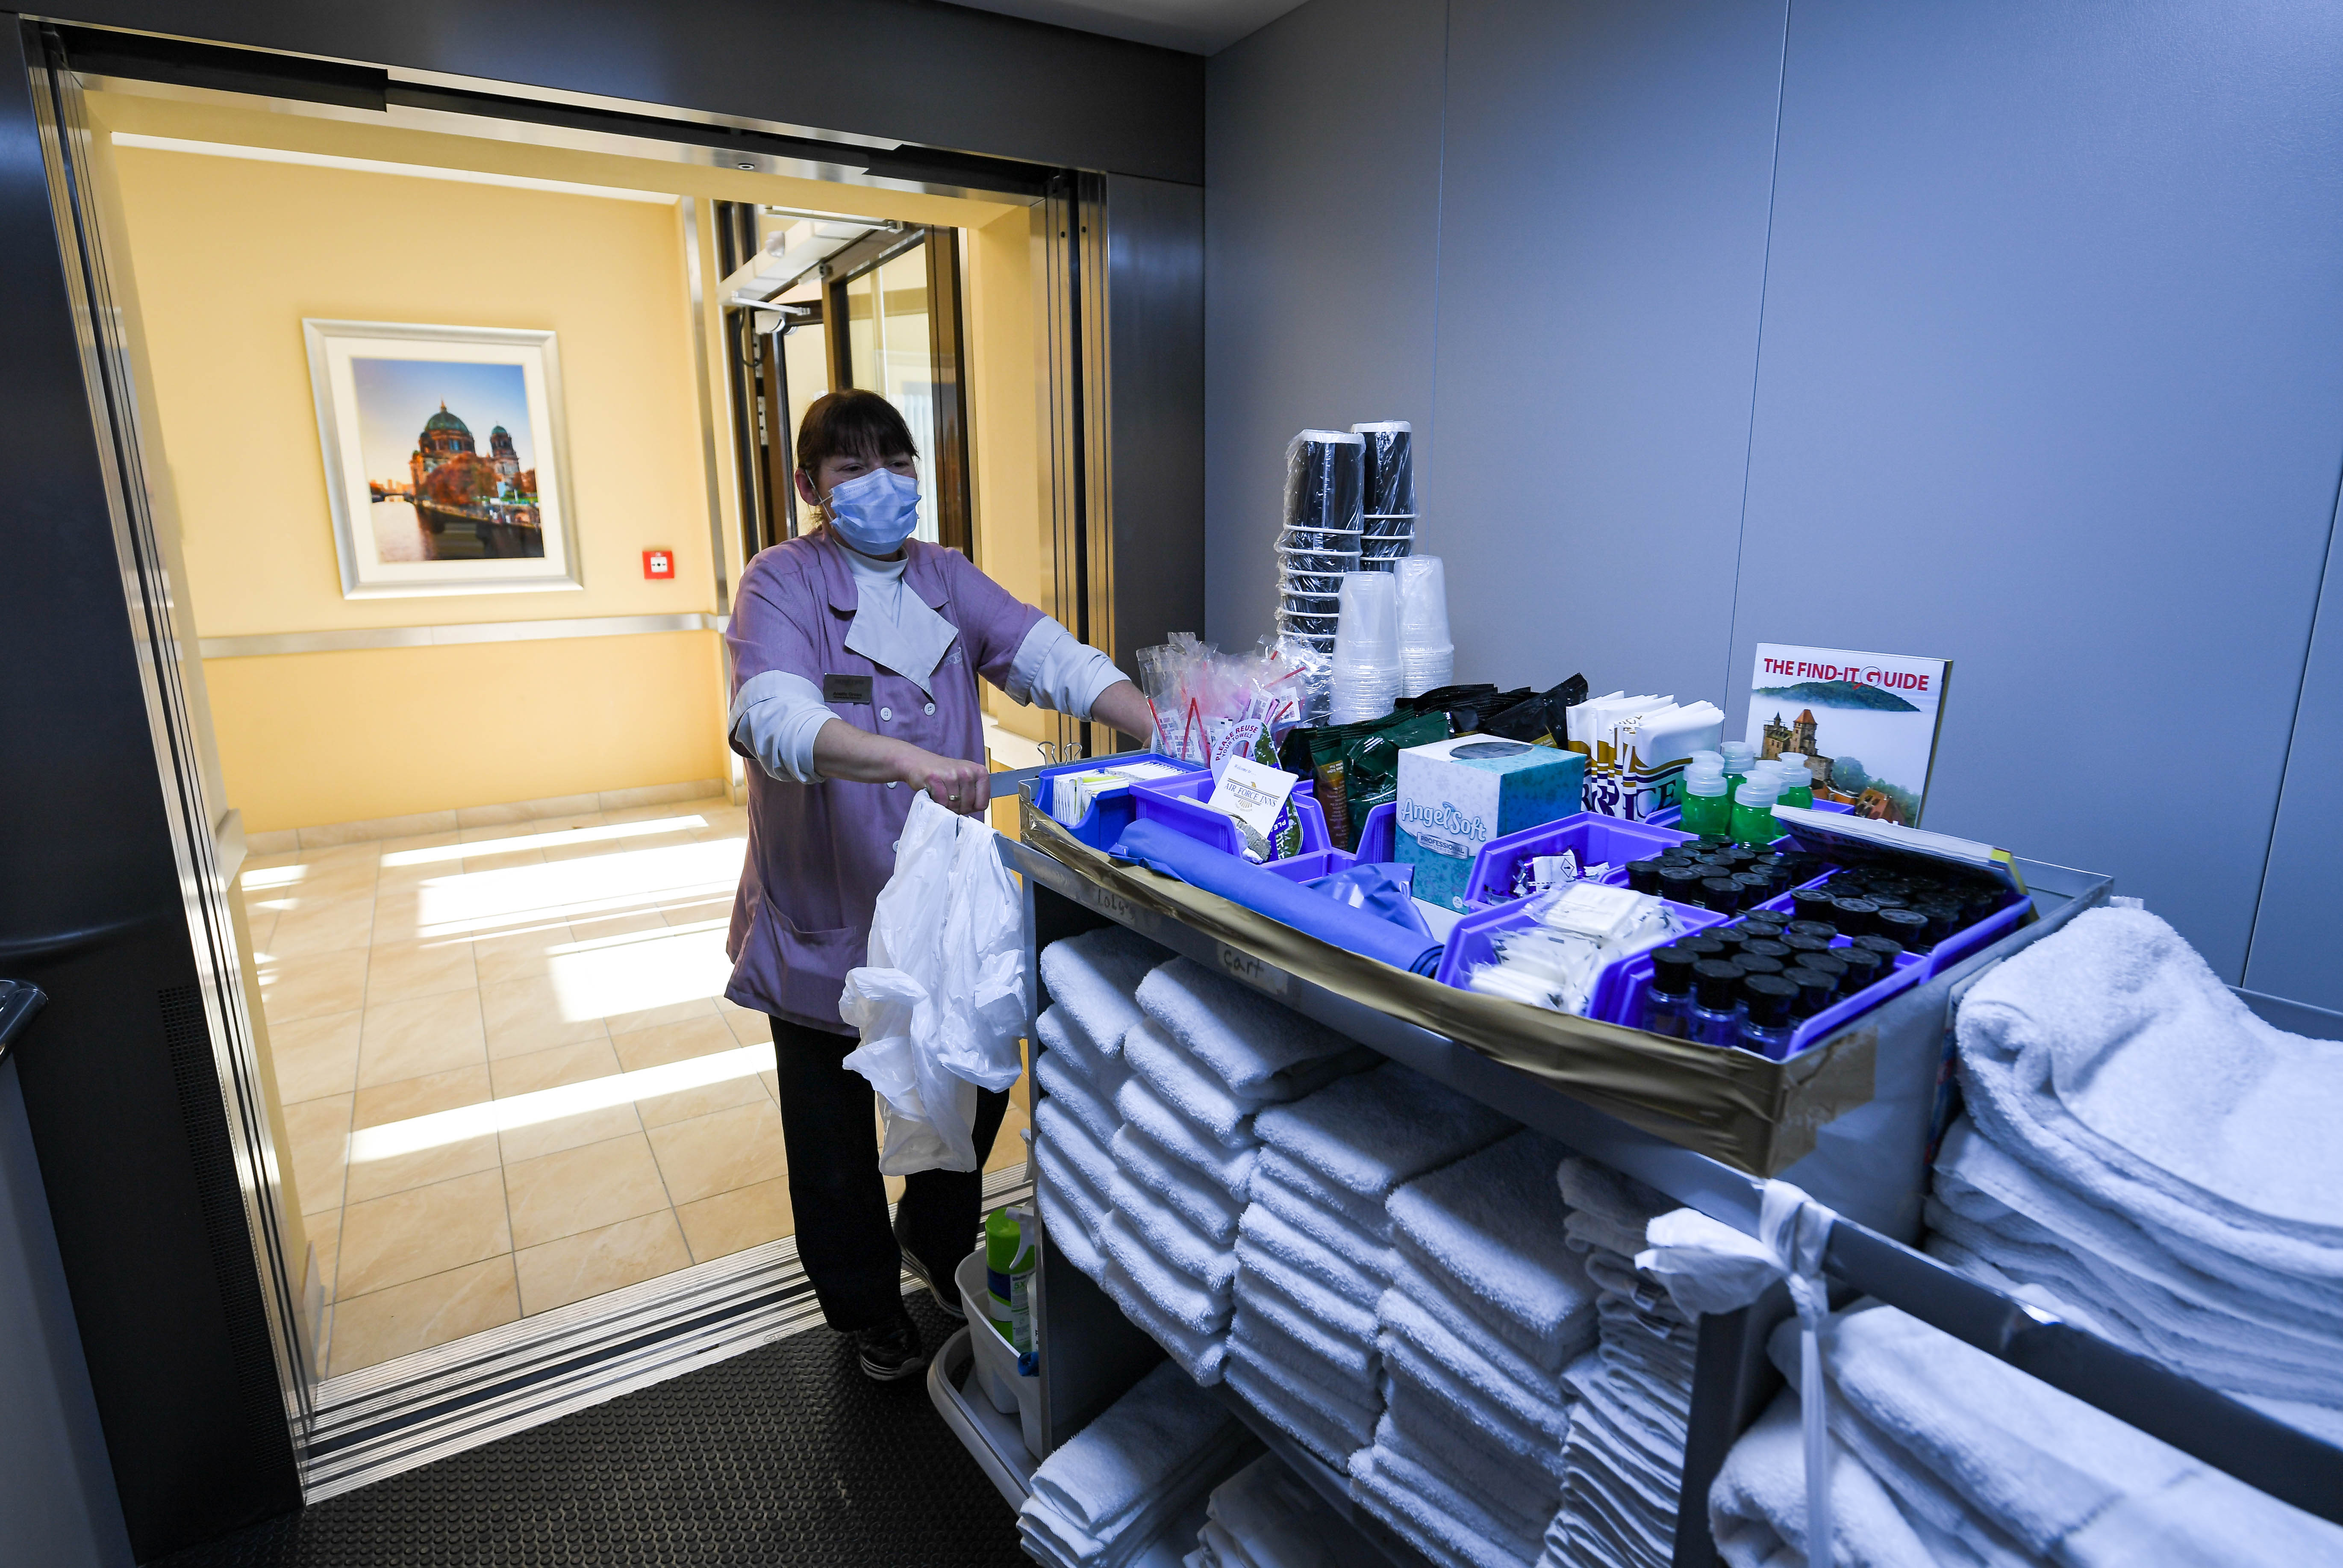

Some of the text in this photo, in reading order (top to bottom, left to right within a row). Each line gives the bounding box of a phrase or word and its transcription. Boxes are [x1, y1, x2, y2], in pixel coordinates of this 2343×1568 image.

[1764, 658, 1930, 691] THE FIND-IT GUIDE
[1215, 732, 1234, 761] PLEASE
[1235, 725, 1258, 733] REUSE
[1222, 732, 1253, 757] YOUR TOWELS
[1224, 782, 1277, 807] AIR FORCE INNS
[1271, 819, 1286, 833] PLE
[1421, 835, 1465, 854] PROFESSIONAL
